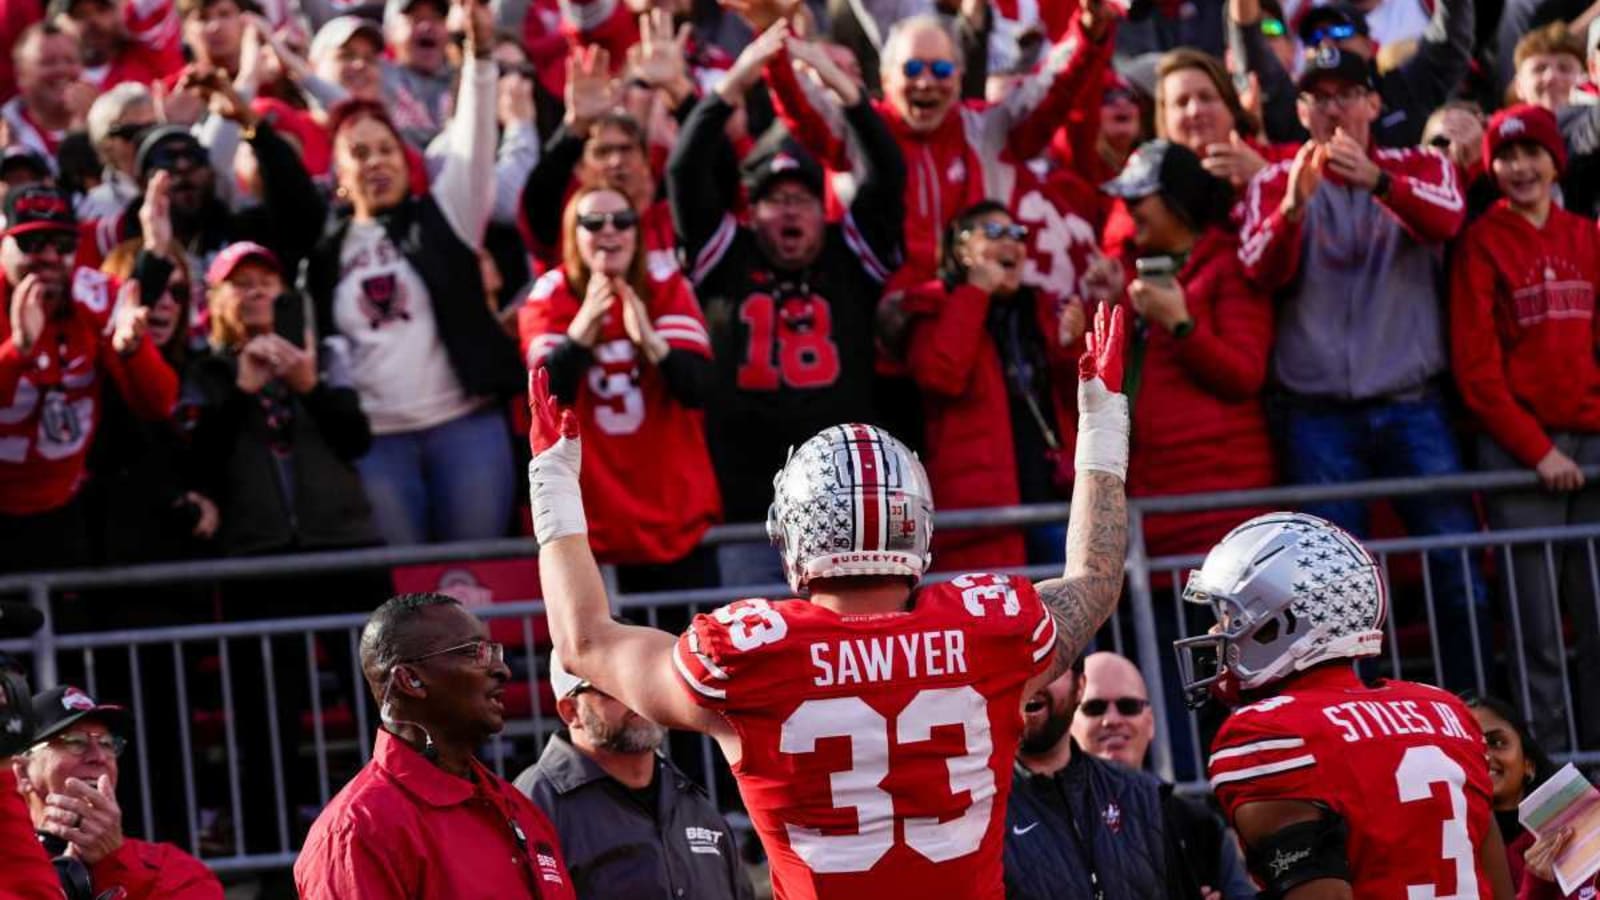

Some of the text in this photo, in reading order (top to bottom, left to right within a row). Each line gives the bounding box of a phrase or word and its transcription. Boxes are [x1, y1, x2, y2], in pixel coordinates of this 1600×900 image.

[738, 293, 840, 388] 18
[832, 554, 908, 564] BUCKEYES
[712, 598, 788, 652] 33
[810, 629, 967, 686] SAWYER
[1322, 700, 1436, 743] STYLES
[780, 685, 997, 873] 33
[685, 826, 723, 844] BEST
[1395, 745, 1479, 900] 3
